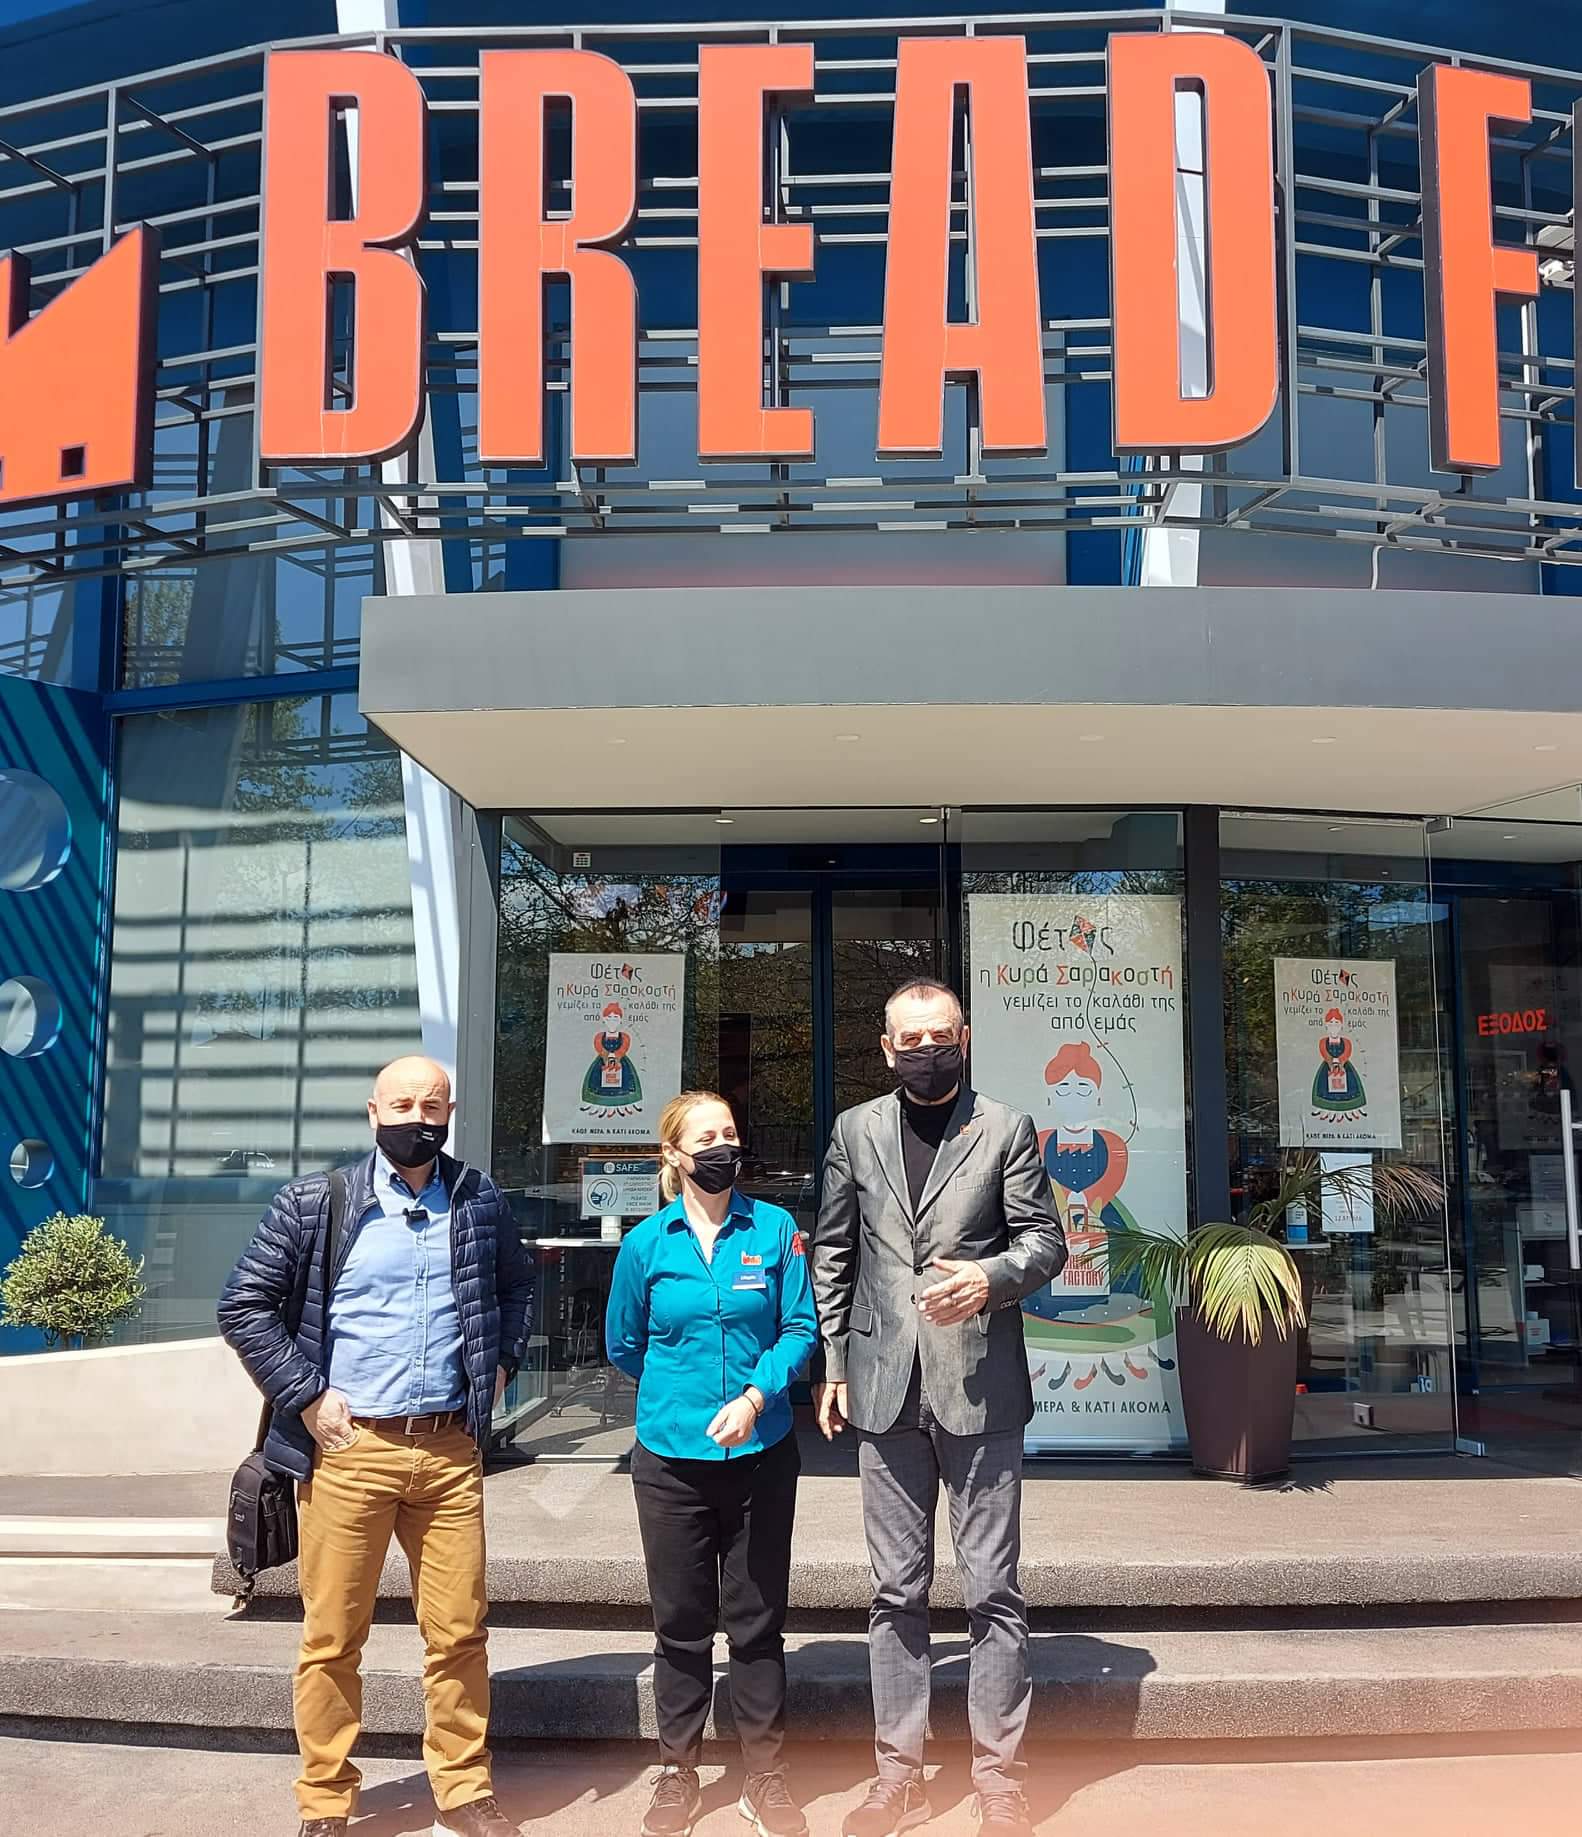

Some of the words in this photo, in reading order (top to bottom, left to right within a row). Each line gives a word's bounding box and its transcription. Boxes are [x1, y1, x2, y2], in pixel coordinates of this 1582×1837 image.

[259, 31, 1281, 469] BREAD
[1418, 61, 1582, 489] F
[979, 968, 991, 988] η
[997, 963, 1049, 988] Κυρά
[1055, 965, 1175, 990] Σαρακοστή
[557, 1000, 589, 1011] γεμίζει
[591, 1001, 601, 1009] το
[628, 1001, 659, 1010] καλάθι
[662, 1002, 677, 1011] της
[1002, 993, 1059, 1011] γεμίζει
[1064, 996, 1082, 1008] το
[1092, 993, 1145, 1009] καλάθι
[1151, 996, 1176, 1011] της
[583, 1013, 600, 1023] από
[628, 1013, 649, 1023] εμάς
[1051, 1014, 1085, 1030] από
[1094, 1014, 1137, 1033] εμάς
[1477, 1008, 1548, 1036] ΕΞΟΔΟΣ
[615, 1163, 640, 1172] SAFE
[1063, 1270, 1105, 1286] FACTORY
[1071, 1401, 1081, 1413] &
[1085, 1401, 1116, 1414] ΚΑΤΙ
[1120, 1401, 1172, 1414] ΑΚΟΜΑ
